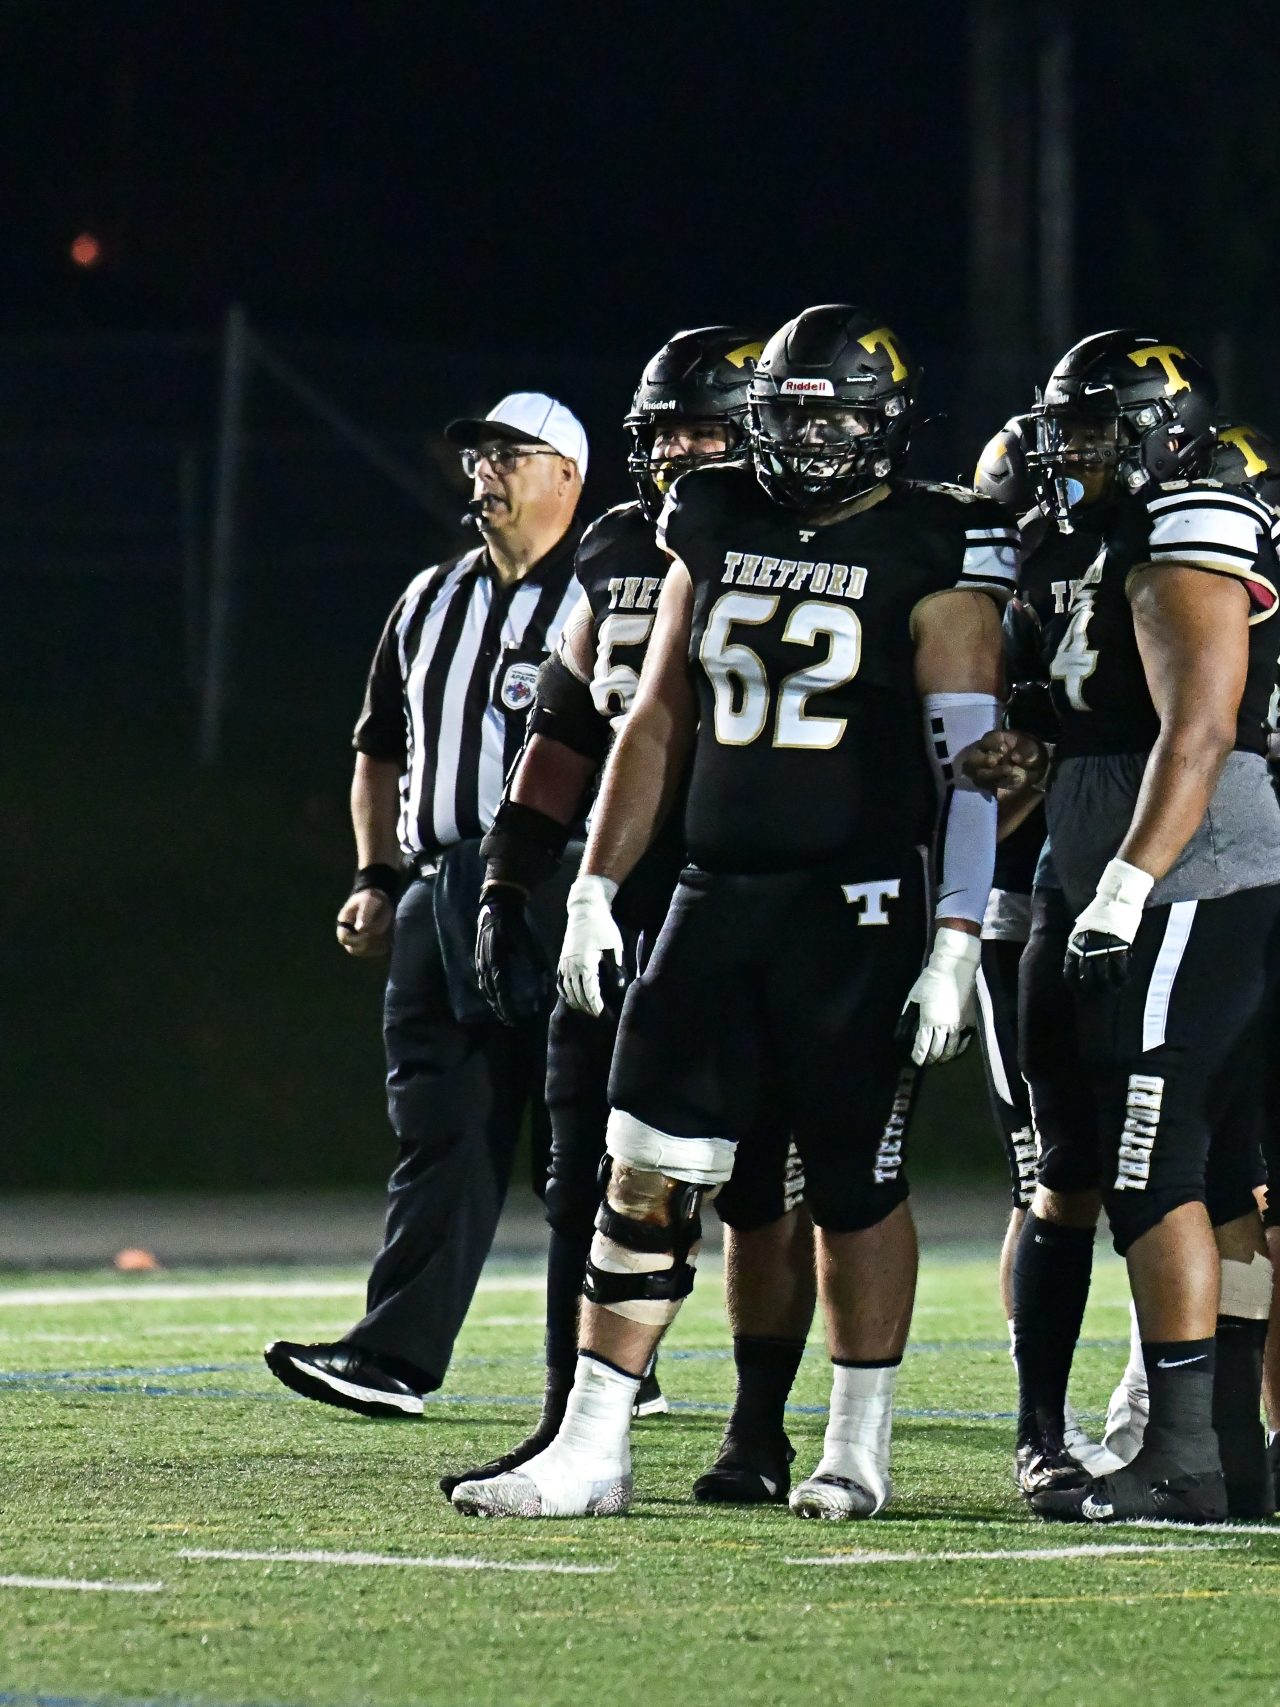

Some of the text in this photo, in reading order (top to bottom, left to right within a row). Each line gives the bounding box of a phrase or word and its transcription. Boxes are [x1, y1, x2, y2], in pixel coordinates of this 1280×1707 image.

[643, 400, 676, 411] Riddell
[786, 381, 826, 391] Riddell
[721, 551, 868, 599] THETFORD
[699, 591, 862, 750] 62
[841, 879, 901, 926] T
[1113, 1073, 1165, 1191] THETFORD
